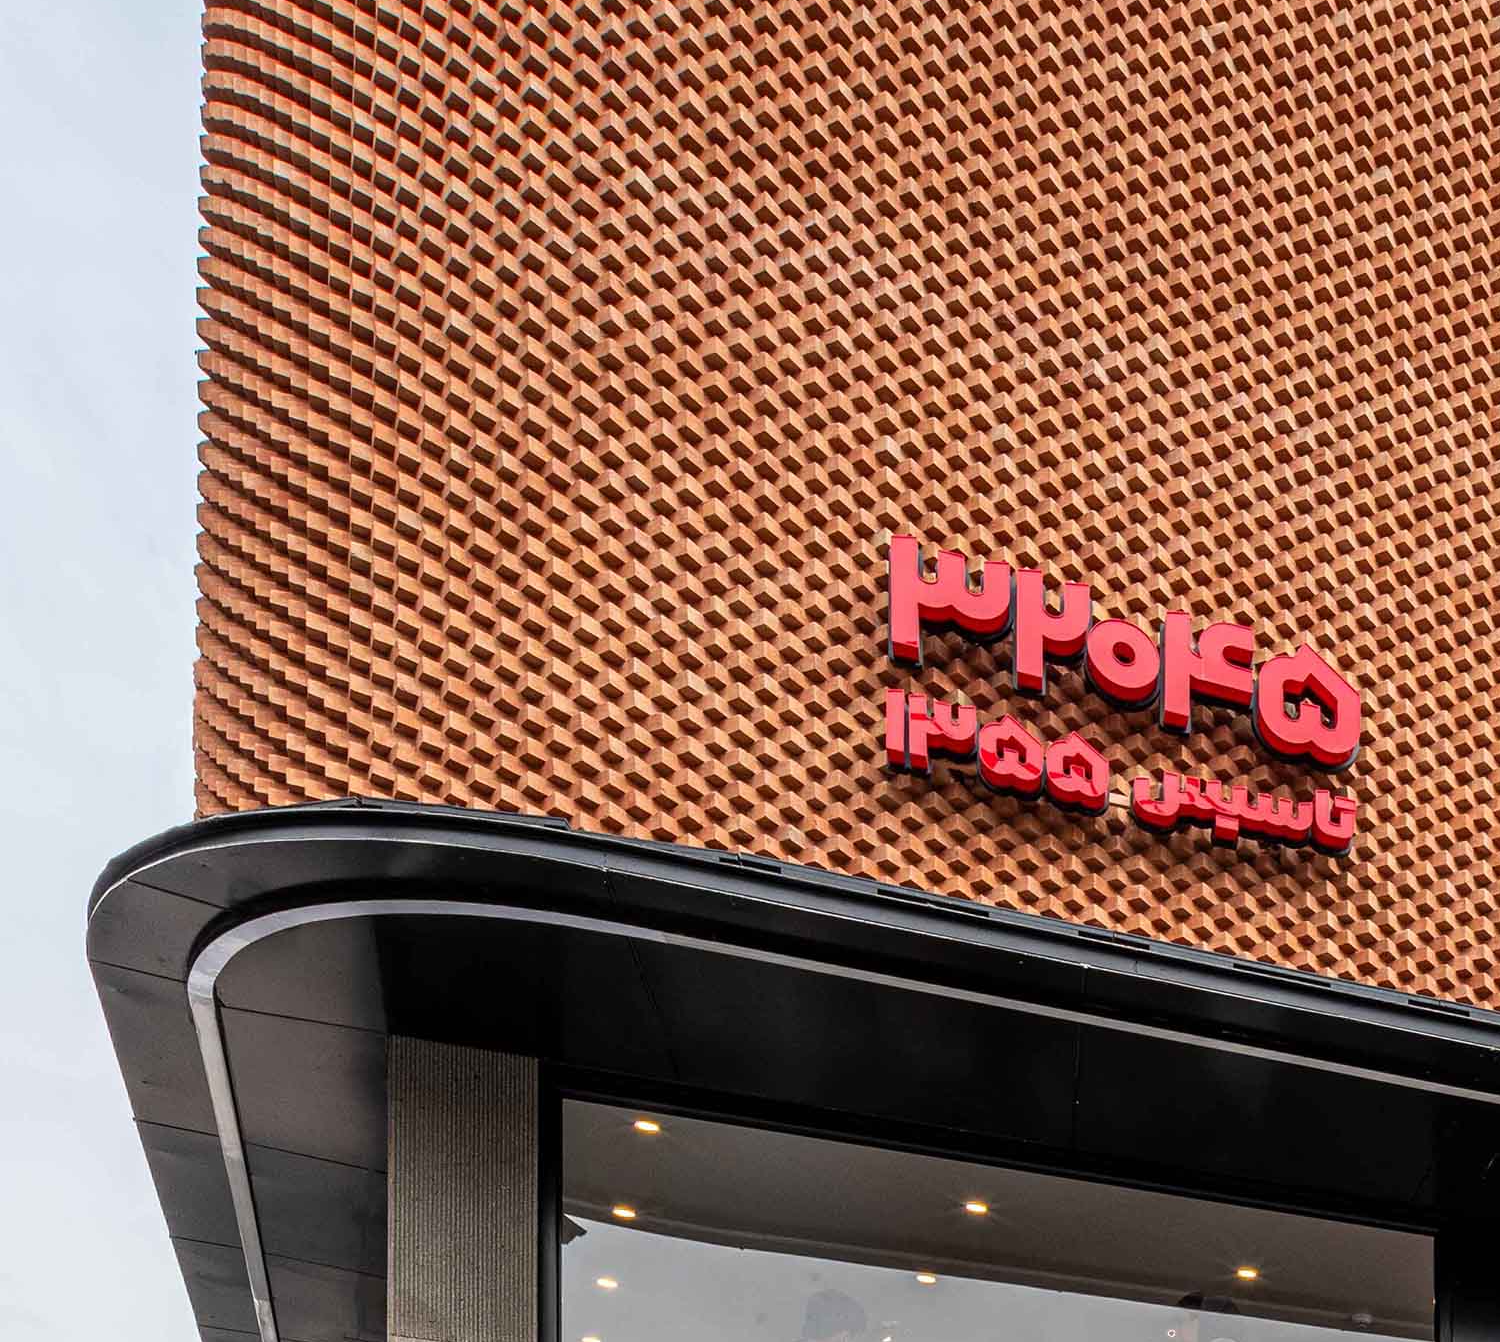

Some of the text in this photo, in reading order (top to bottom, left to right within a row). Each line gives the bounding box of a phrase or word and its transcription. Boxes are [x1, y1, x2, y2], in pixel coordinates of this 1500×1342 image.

[889, 535, 1361, 768] ۳۲۰۴۵
[886, 688, 1357, 853] تاسیس ۱۳۵۵
